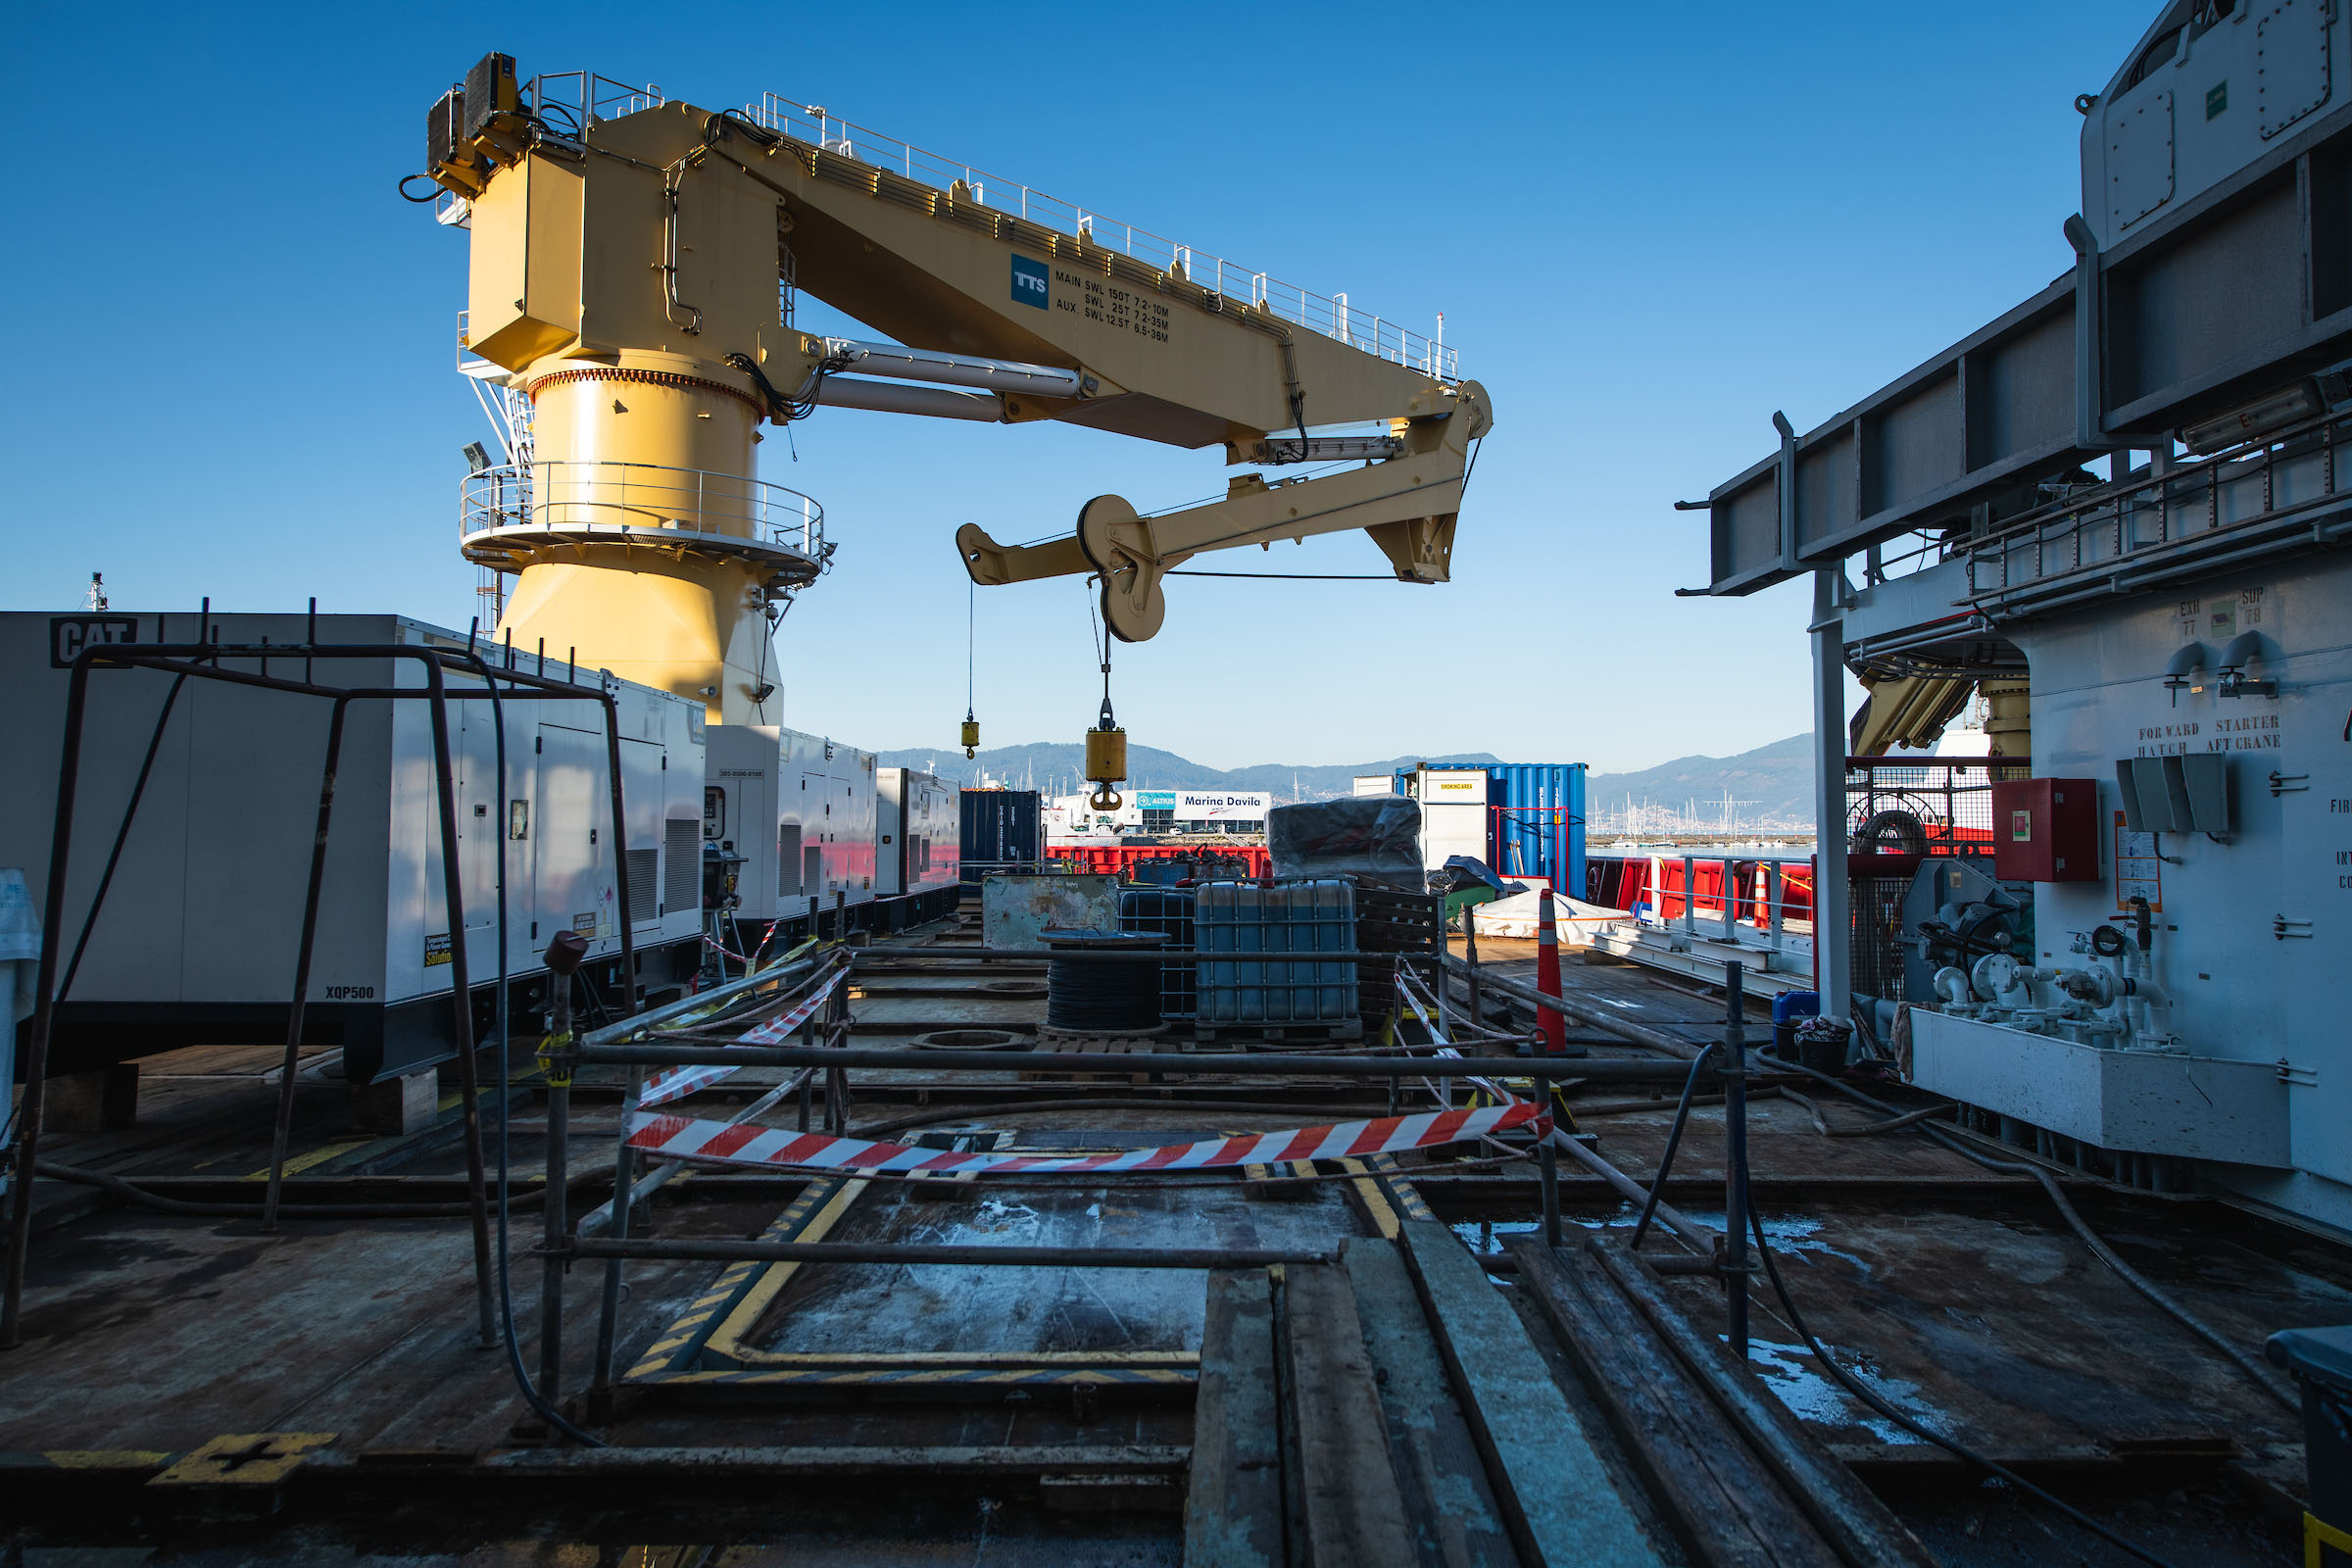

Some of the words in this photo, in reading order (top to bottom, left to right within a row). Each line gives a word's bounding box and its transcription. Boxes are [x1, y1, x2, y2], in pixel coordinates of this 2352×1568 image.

[1014, 271, 1046, 293] TTS
[1055, 270, 1081, 287] MAIN
[1085, 281, 1103, 295] SWL
[1108, 288, 1130, 303] 150T
[1134, 297, 1169, 318] 7.2-10M
[1056, 298, 1079, 315] AUX.
[1085, 308, 1103, 322] SWL
[1106, 314, 1130, 329] 12.5T
[1134, 323, 1169, 344] 6.5-36M
[1085, 294, 1103, 309] SWL
[1112, 302, 1130, 317] 25T
[1134, 311, 1169, 330] 7.2-35M
[2242, 587, 2264, 605] SUP
[2182, 619, 2195, 635] 77
[59, 621, 128, 663] CAT
[2139, 722, 2199, 741] FORWARD
[2216, 714, 2279, 733] STARTER
[2138, 742, 2186, 758] HATCH
[2207, 737, 2231, 753] AFT
[2235, 734, 2280, 750] CRANE
[1185, 796, 1223, 806] Marina
[1227, 797, 1261, 807] Davila
[2330, 799, 2352, 813] FIR
[325, 986, 374, 1000] XQP500
